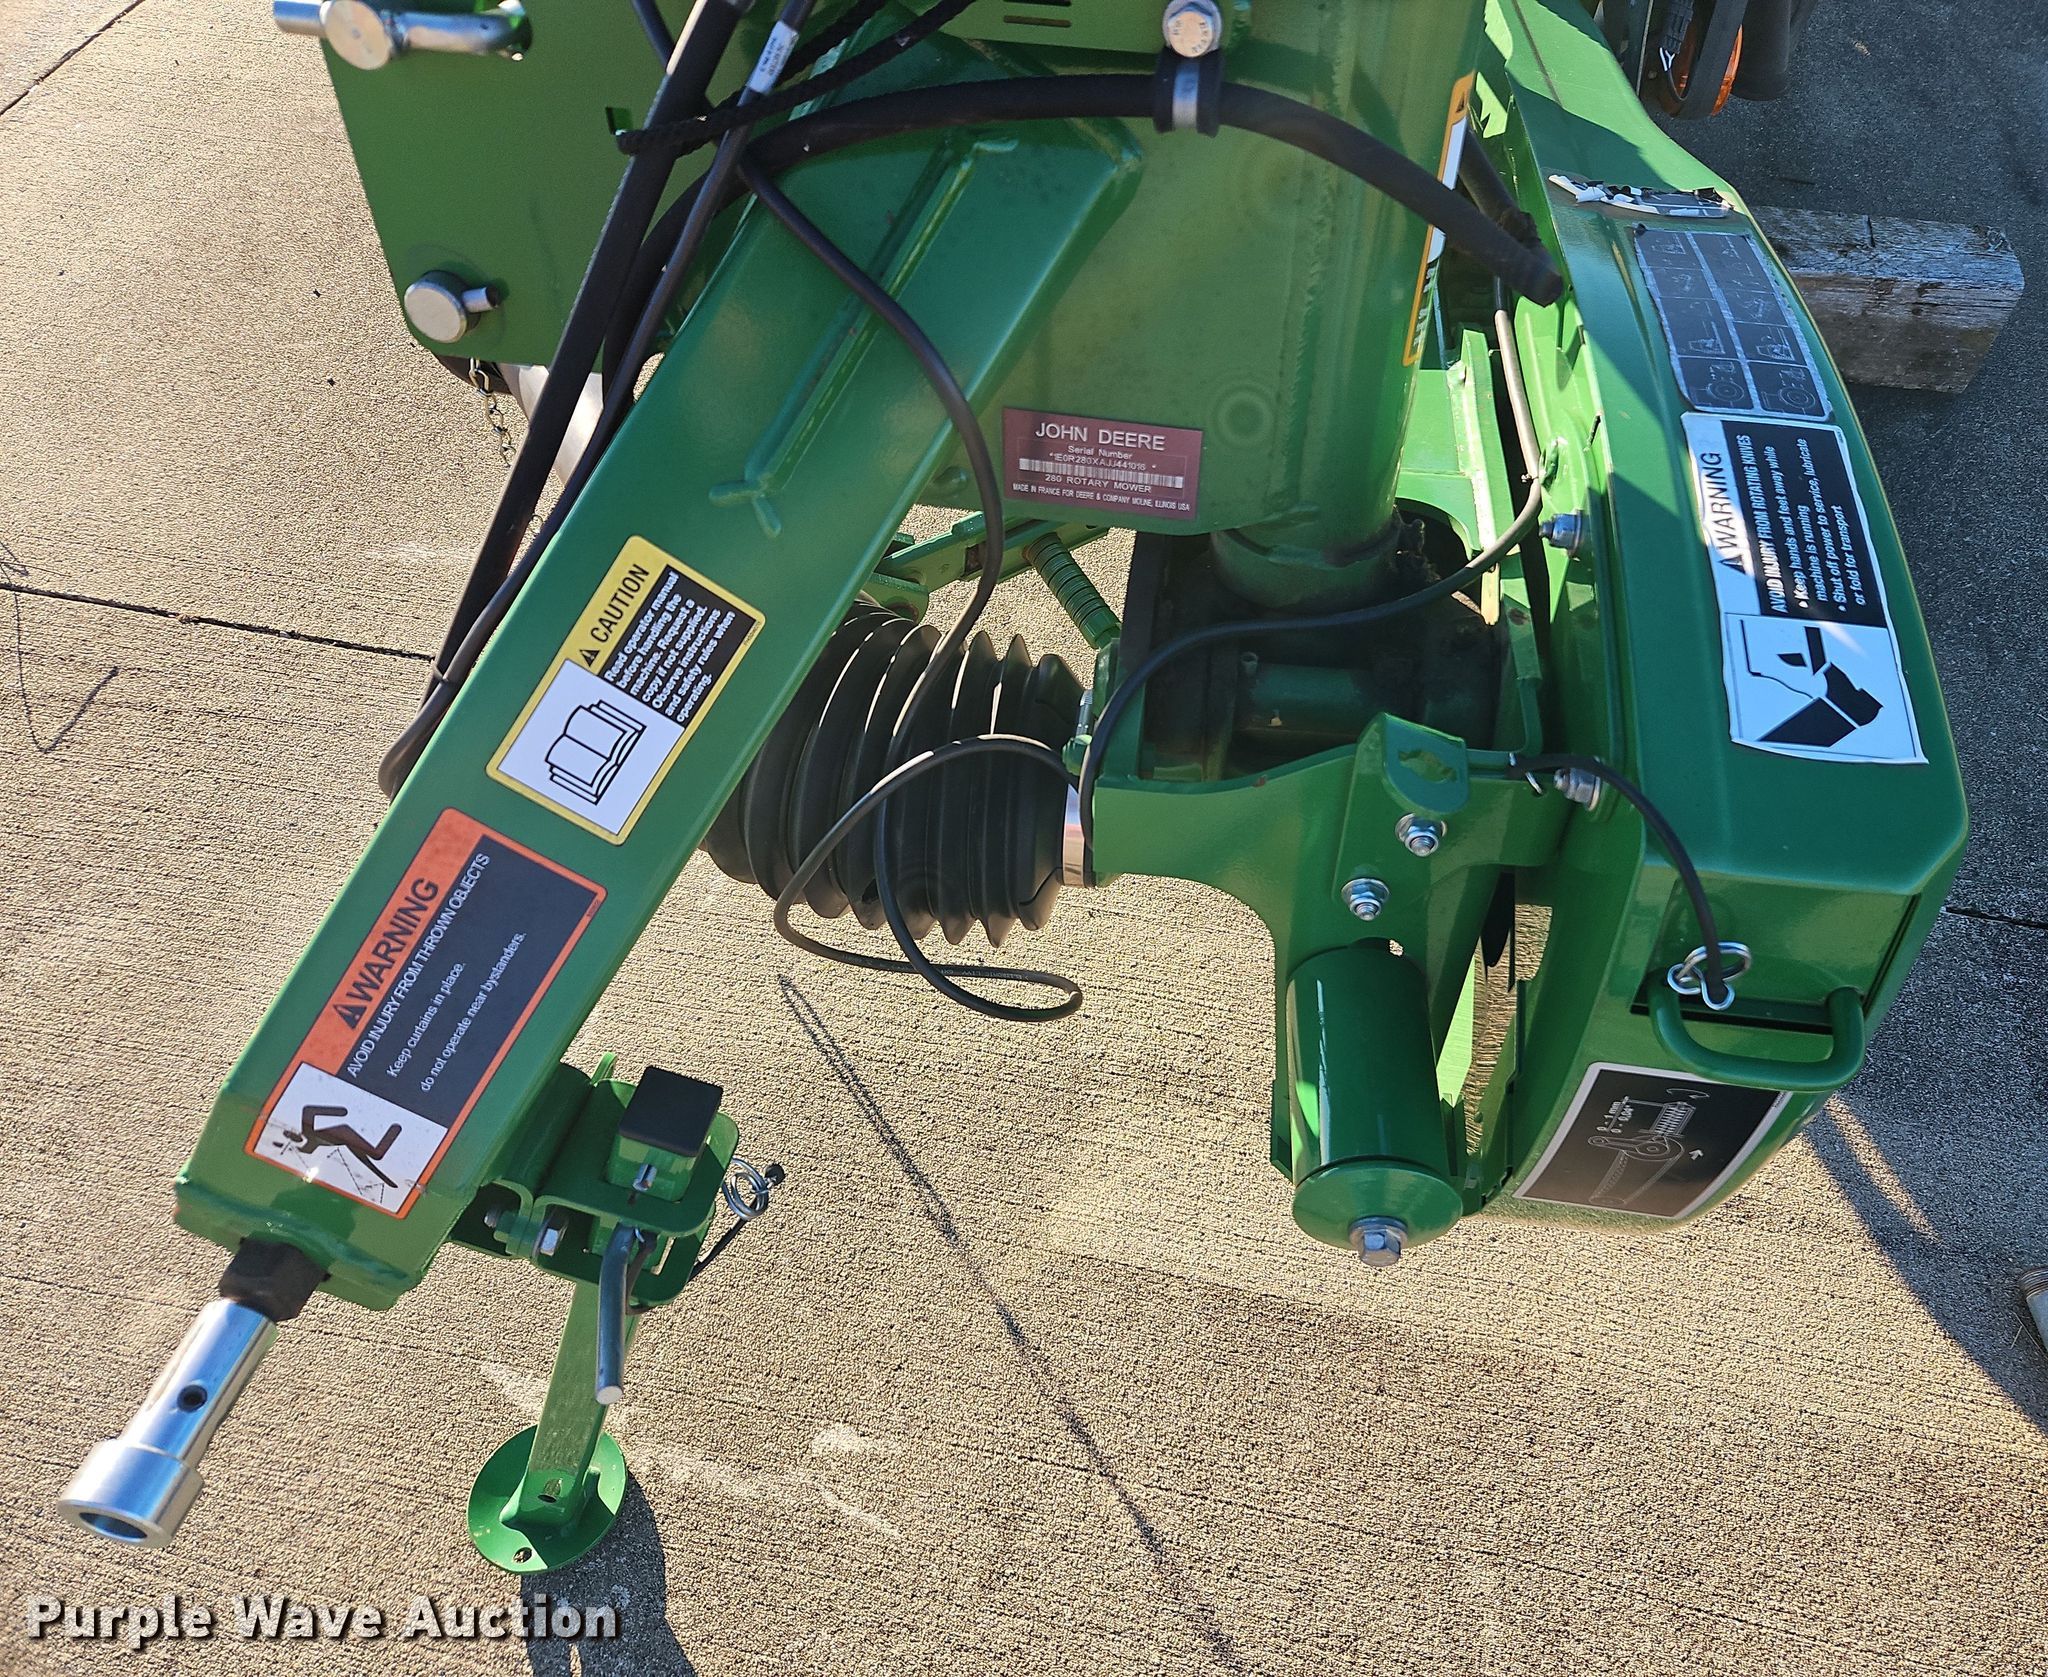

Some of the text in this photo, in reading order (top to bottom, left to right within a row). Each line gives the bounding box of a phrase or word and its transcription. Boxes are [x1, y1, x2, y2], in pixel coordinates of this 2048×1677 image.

[1035, 422, 1166, 451] JOHN DEERE
[1045, 474, 1152, 493] 280 ROTARY MOWER
[1068, 445, 1133, 460] Serial Number
[1012, 483, 1029, 492] MADE
[1031, 485, 1037, 493] IN
[1038, 486, 1061, 497] FRANCE
[1062, 488, 1074, 498] FOR
[1076, 490, 1095, 500] DEERE
[1102, 494, 1130, 504] COMPANY
[1178, 501, 1190, 511] USA
[1700, 452, 1738, 549] WARNING
[1736, 434, 1789, 613] AVOID INJURY FROM ROTATING KNIVES
[1764, 446, 1809, 600] Keep hands and feet away while
[1796, 438, 1847, 603] Shut off power to service, lubricate
[590, 563, 649, 643] CAUTION
[1797, 505, 1828, 602] machine is running
[1831, 505, 1866, 606] or fold for transport
[604, 570, 679, 682] Read operator manual
[616, 593, 682, 688] before handling the
[630, 599, 695, 696] machine. Request a
[642, 605, 708, 702] copy if not supplied.
[652, 608, 721, 709] Observe instructions
[665, 611, 736, 716] and safety rules when
[676, 673, 713, 723] operating.
[346, 877, 439, 1002] WARNING
[347, 853, 490, 1078] AVOID INJURY FROM THROWN OBJECTS
[386, 963, 466, 1077] Keep curtains in place.
[420, 932, 527, 1093] do not operate near bystanders.
